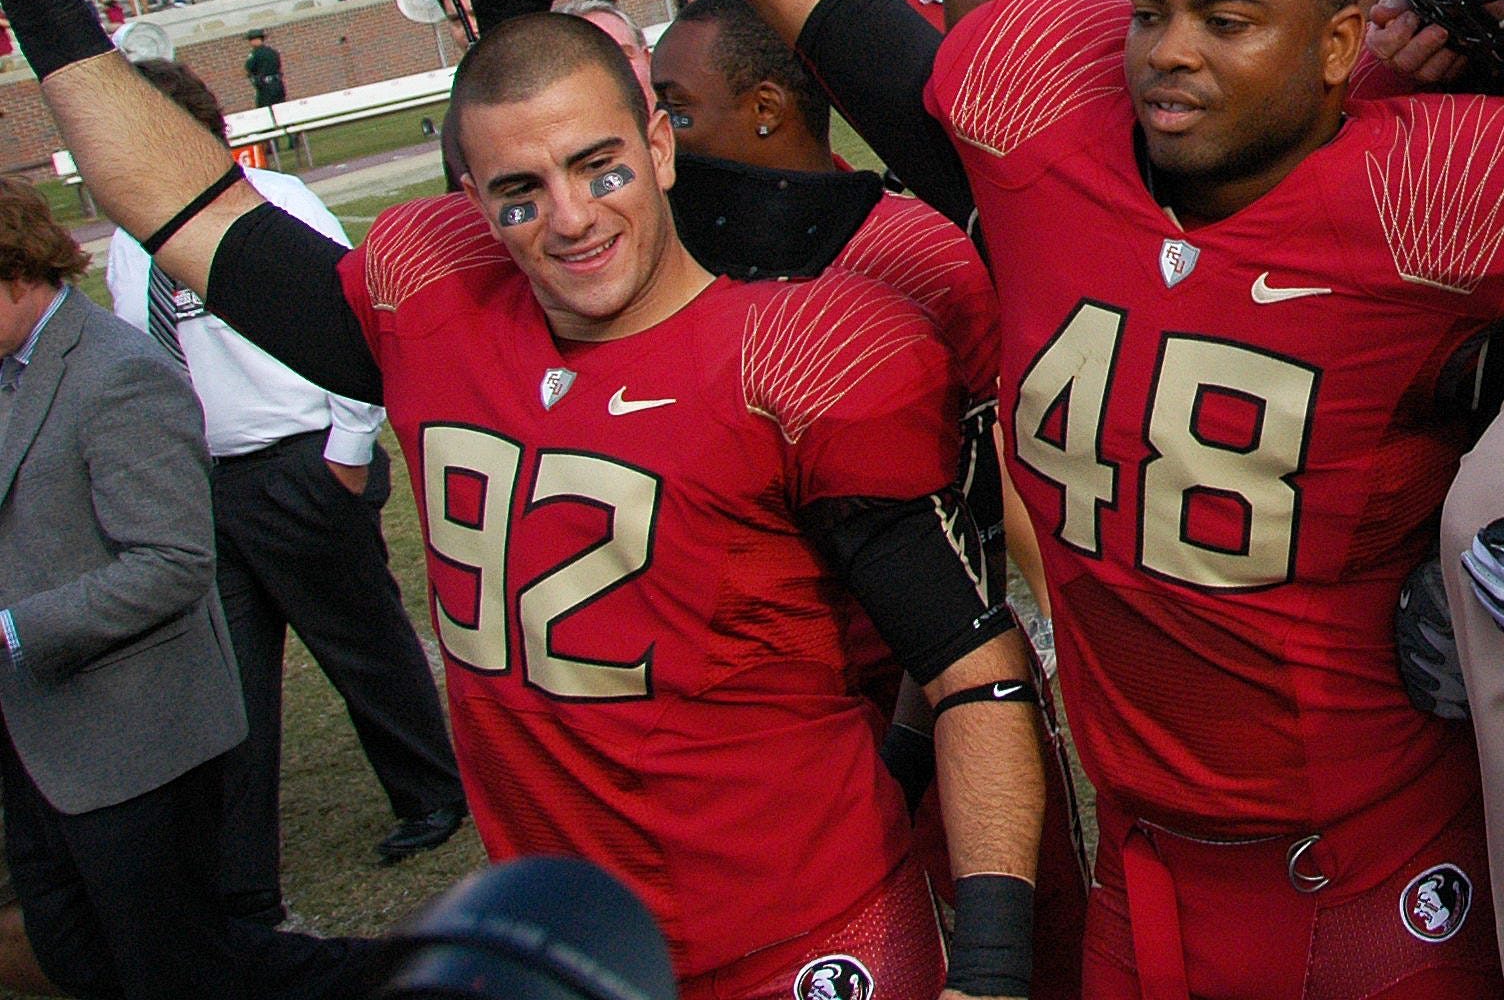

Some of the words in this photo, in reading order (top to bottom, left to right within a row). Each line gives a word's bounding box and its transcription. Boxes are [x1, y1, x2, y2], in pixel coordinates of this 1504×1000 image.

[1166, 245, 1185, 274] FSU
[419, 420, 664, 704] 92
[1012, 297, 1324, 596] 48
